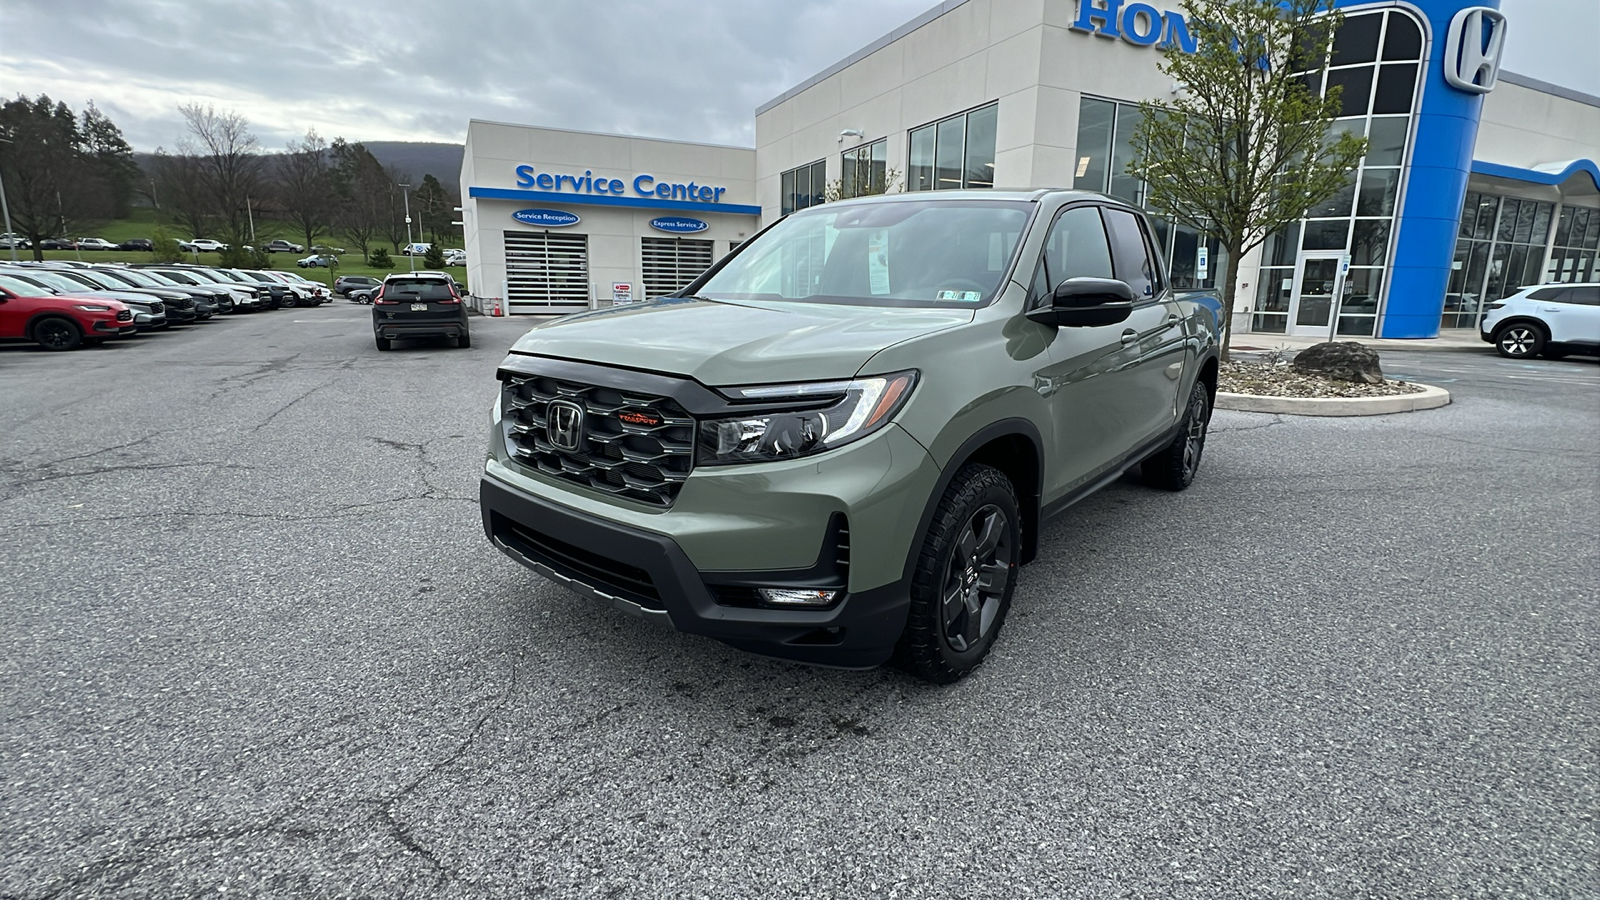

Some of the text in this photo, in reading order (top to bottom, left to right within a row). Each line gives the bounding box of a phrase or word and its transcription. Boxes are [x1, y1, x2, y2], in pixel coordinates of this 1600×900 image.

[1069, 0, 1269, 70] HON
[515, 164, 726, 203] Service Center
[516, 212, 576, 222] Service Reception
[653, 220, 675, 228] Express
